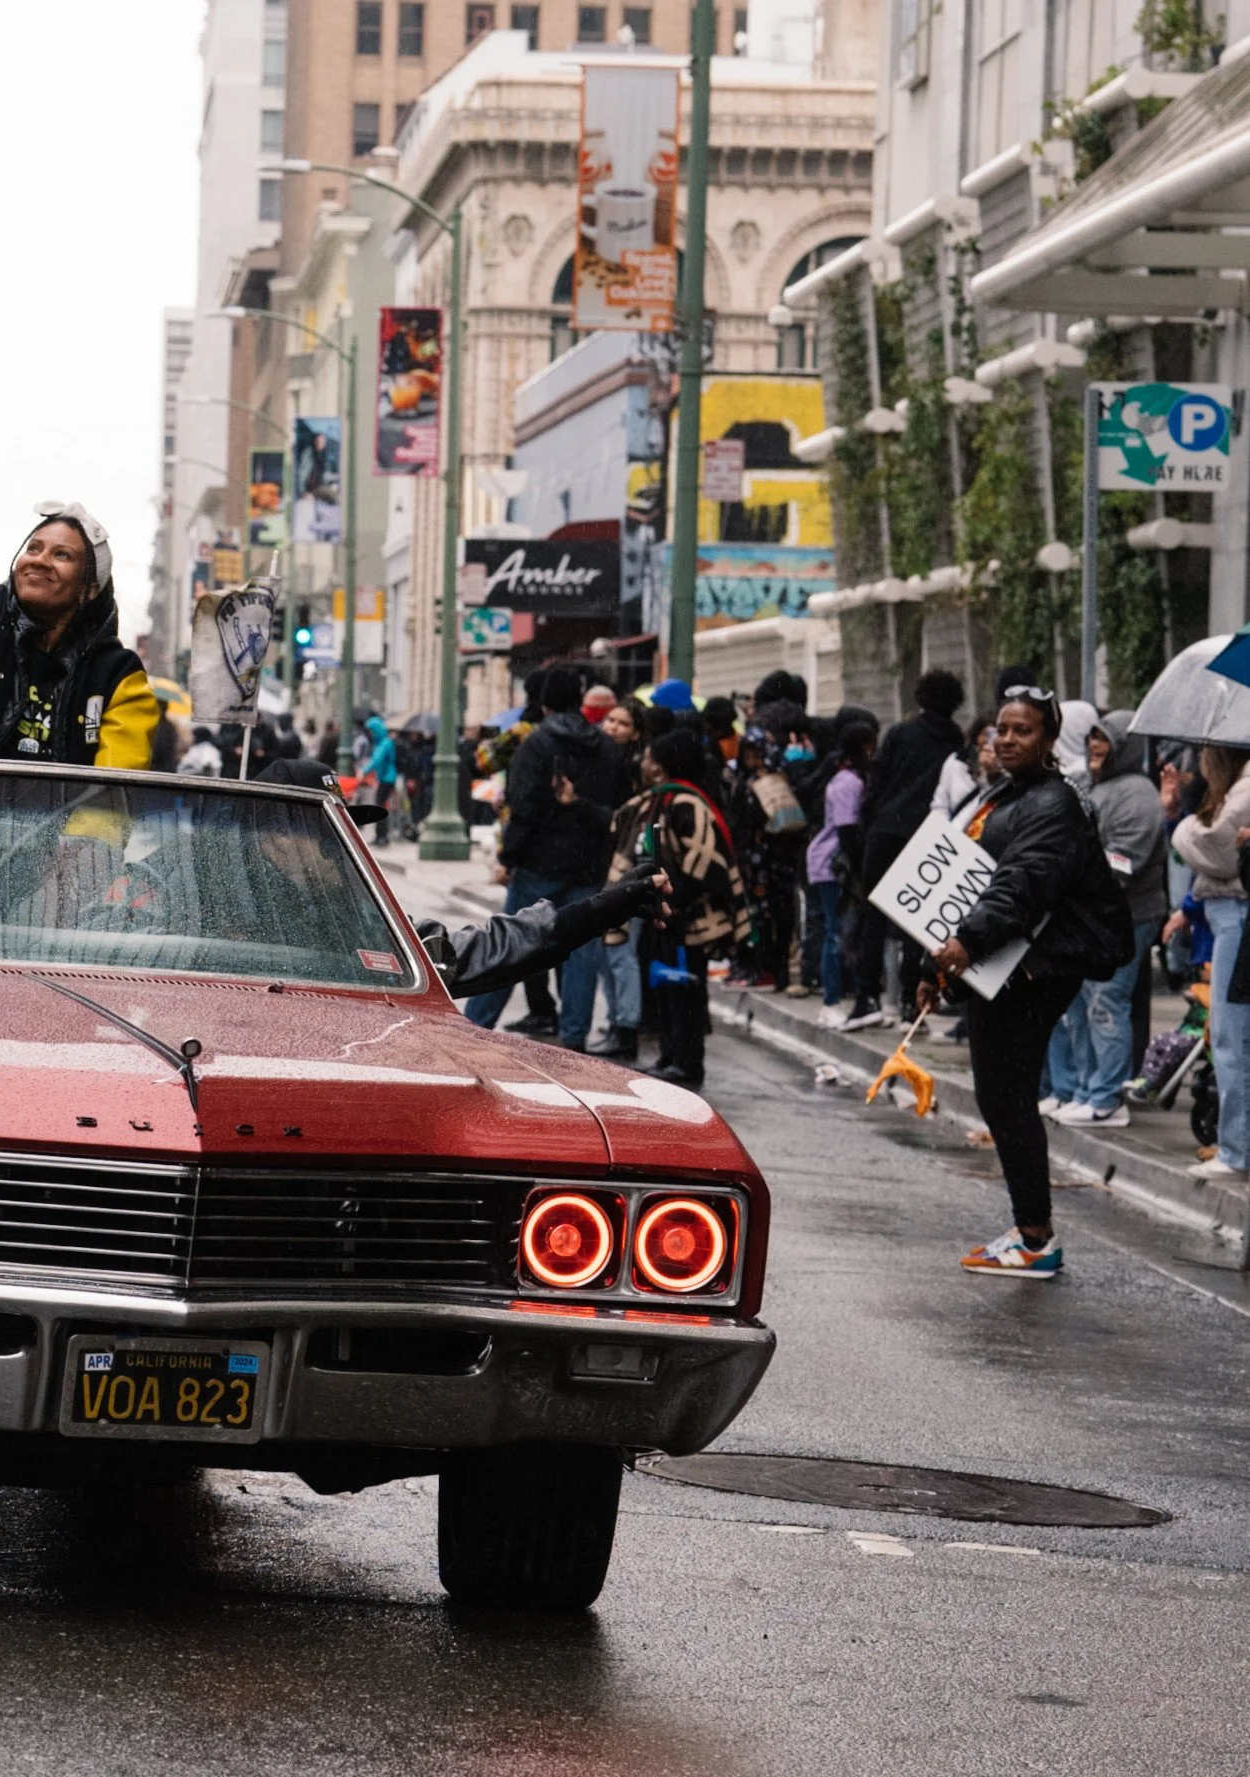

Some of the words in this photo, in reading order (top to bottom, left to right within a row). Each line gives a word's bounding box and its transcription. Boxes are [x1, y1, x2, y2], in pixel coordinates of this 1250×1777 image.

[1180, 404, 1216, 443] P
[483, 548, 603, 598] Amber
[897, 833, 959, 914] SLOW
[925, 857, 994, 944] DOWN
[76, 1116, 304, 1138] BUICK
[87, 1355, 112, 1369] APR
[126, 1353, 212, 1369] CALIFORNIA
[235, 1357, 253, 1367] 2024
[83, 1373, 161, 1421] VOA
[176, 1377, 250, 1425] 823
